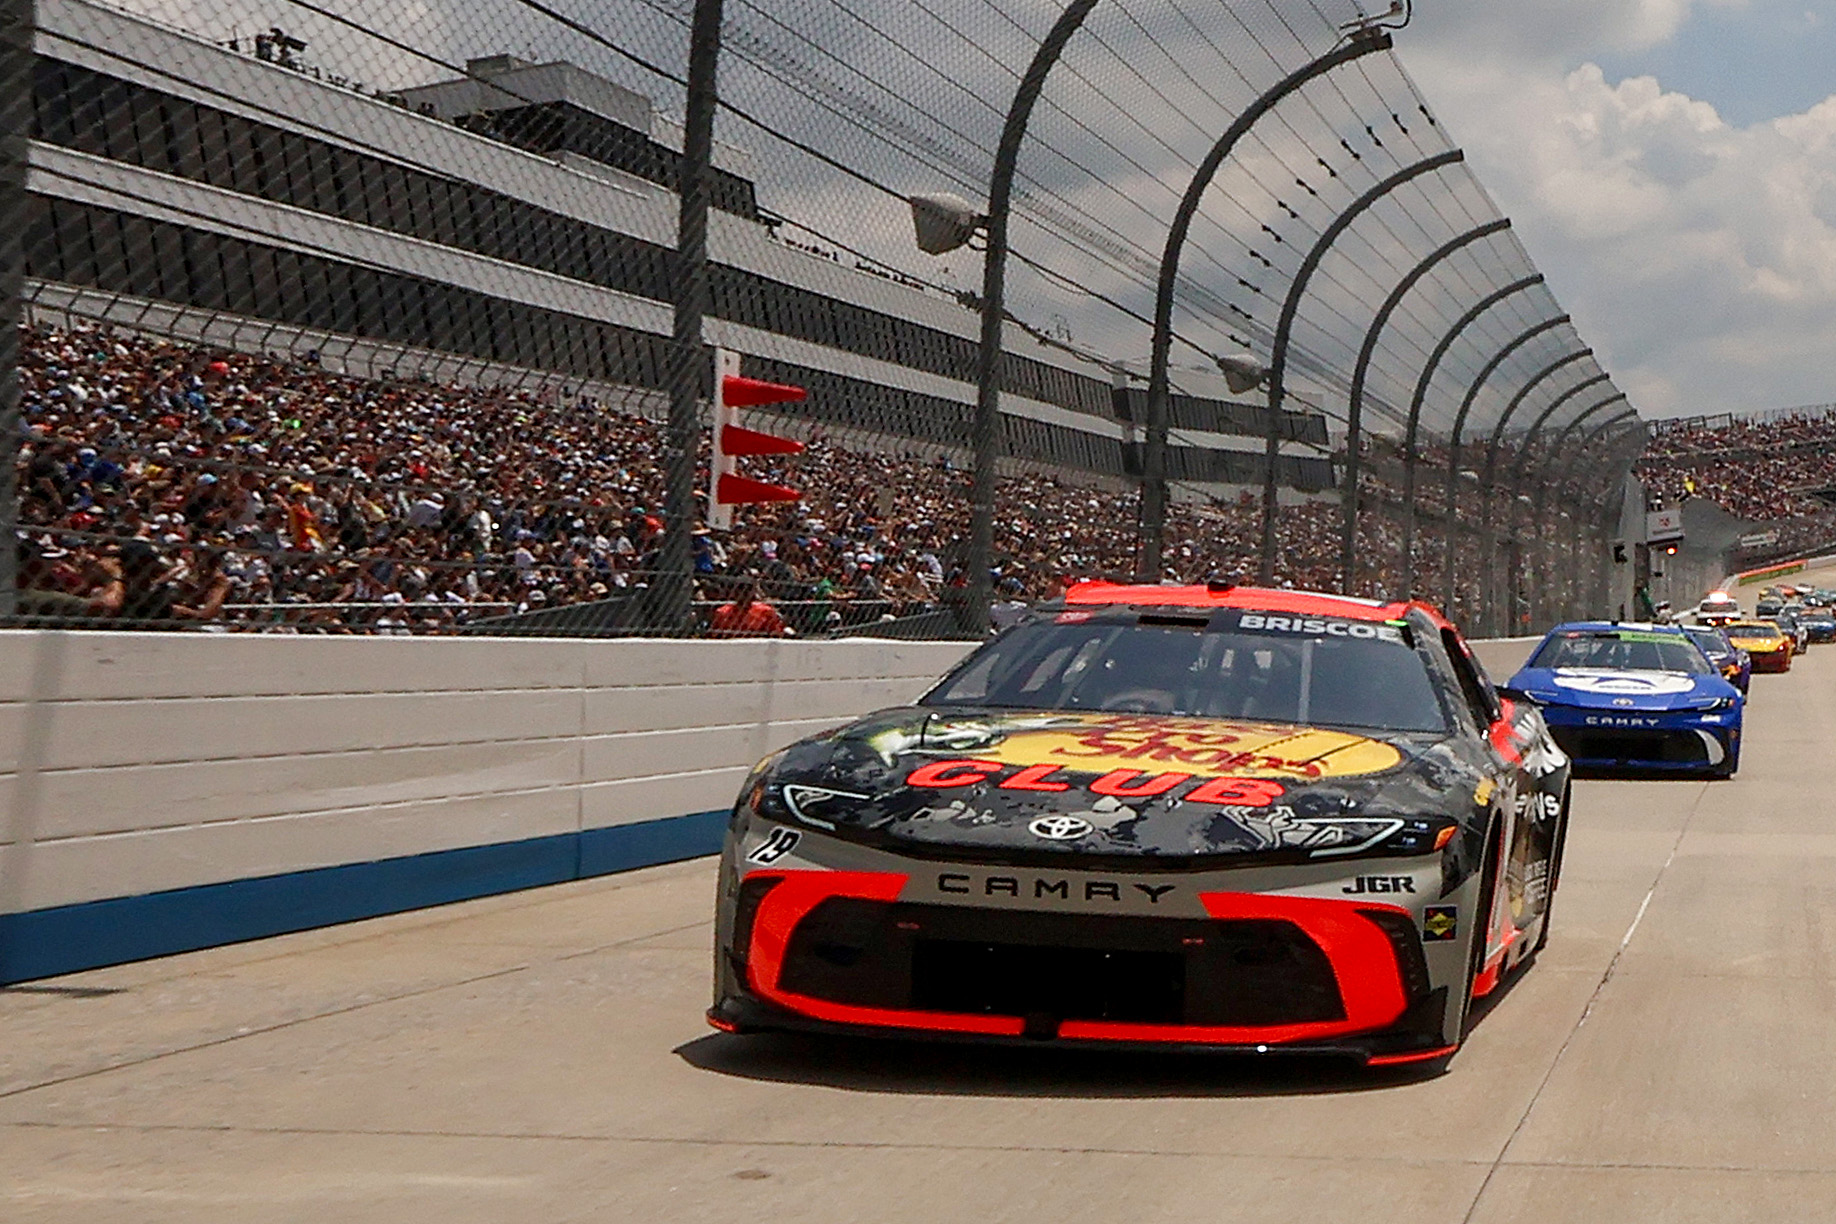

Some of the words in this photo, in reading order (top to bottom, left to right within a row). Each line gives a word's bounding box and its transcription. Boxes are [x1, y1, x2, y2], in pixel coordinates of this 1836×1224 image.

[1239, 614, 1401, 641] BRISCOE
[1585, 716, 1660, 727] CAMRY
[1050, 735, 1329, 777] Shops
[906, 759, 1286, 807] CLUB
[750, 828, 801, 865] 19
[938, 874, 1176, 904] CAMRY
[1342, 876, 1416, 894] JGR
